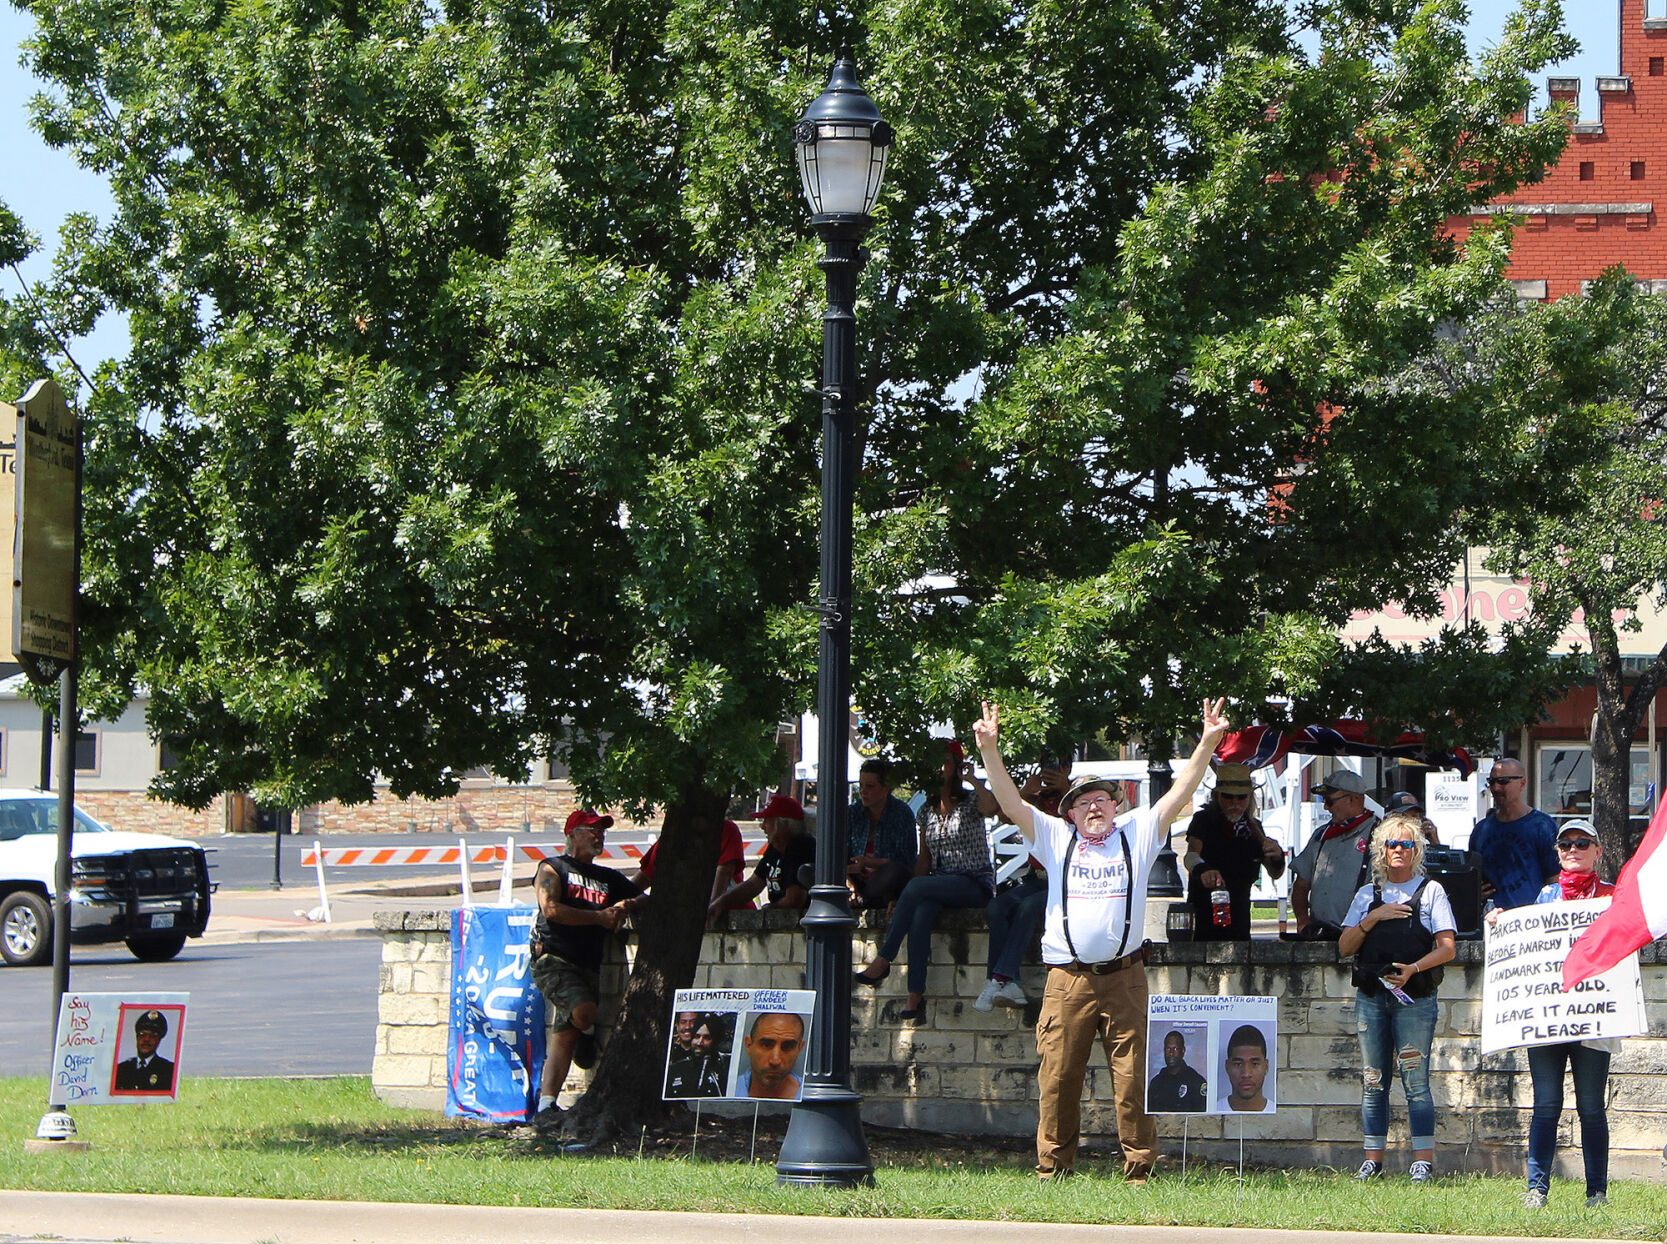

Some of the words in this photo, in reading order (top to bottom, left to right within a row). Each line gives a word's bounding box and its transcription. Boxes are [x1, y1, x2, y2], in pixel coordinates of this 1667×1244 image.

[1072, 863, 1125, 879] TRUMP
[1489, 920, 1523, 944] PARKER
[1541, 912, 1569, 928] WAS
[1571, 911, 1604, 927] PEAC
[1487, 945, 1516, 964] BEFORE
[1518, 939, 1562, 956] ANARCHY
[1490, 963, 1541, 984] LANDMARK
[676, 992, 688, 1003] HIS
[689, 992, 705, 1001] LIFE
[705, 990, 750, 1001] MATTERED
[754, 990, 788, 998] OFFICER
[1151, 995, 1163, 1004] DO
[1178, 995, 1199, 1003] BLACK
[1497, 986, 1519, 1002] 105
[68, 996, 91, 1020] Say
[1150, 1005, 1171, 1013] WHEN
[1172, 1004, 1188, 1012] IT'S
[1190, 1004, 1235, 1012] CONVENIENT?
[1495, 1007, 1534, 1024] LEAVE
[1543, 1005, 1561, 1018] IT
[1566, 1001, 1616, 1016] ALONE
[70, 1012, 89, 1031] his
[64, 1054, 95, 1072] Officer
[58, 1068, 88, 1086] David
[67, 1085, 99, 1100] Dorn
